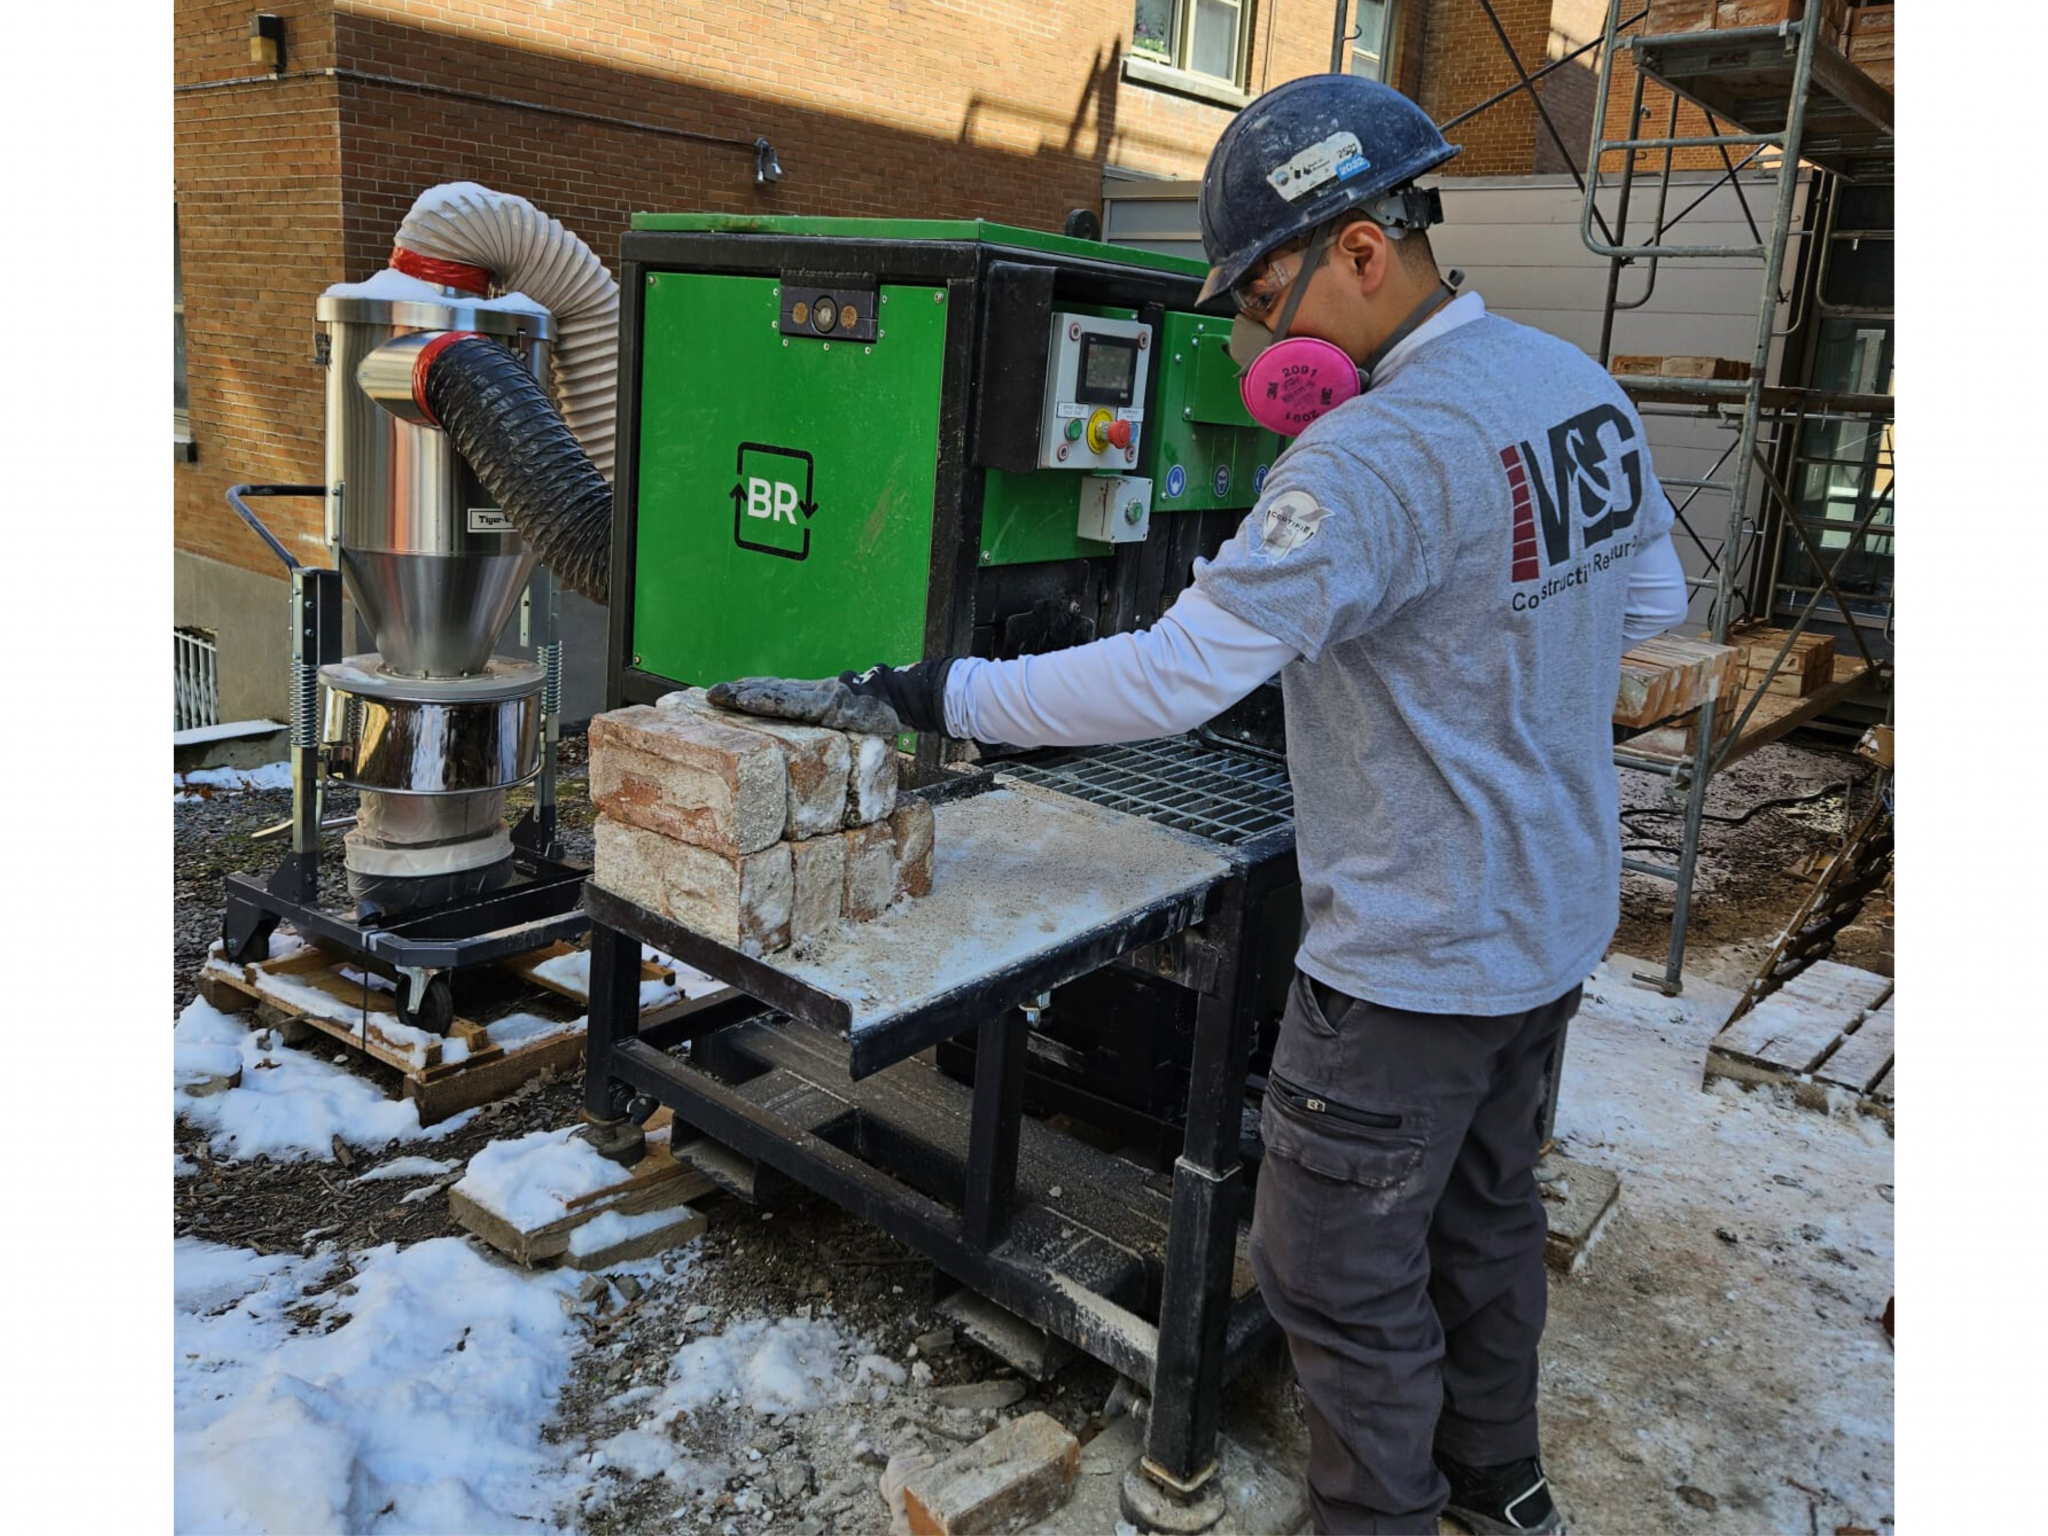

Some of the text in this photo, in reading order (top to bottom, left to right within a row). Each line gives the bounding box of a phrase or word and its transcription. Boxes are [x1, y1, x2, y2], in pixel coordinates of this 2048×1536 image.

[1282, 365, 1318, 378] 2091
[1267, 382, 1278, 399] 3M
[1321, 388, 1333, 405] 3M
[747, 476, 799, 525] BR
